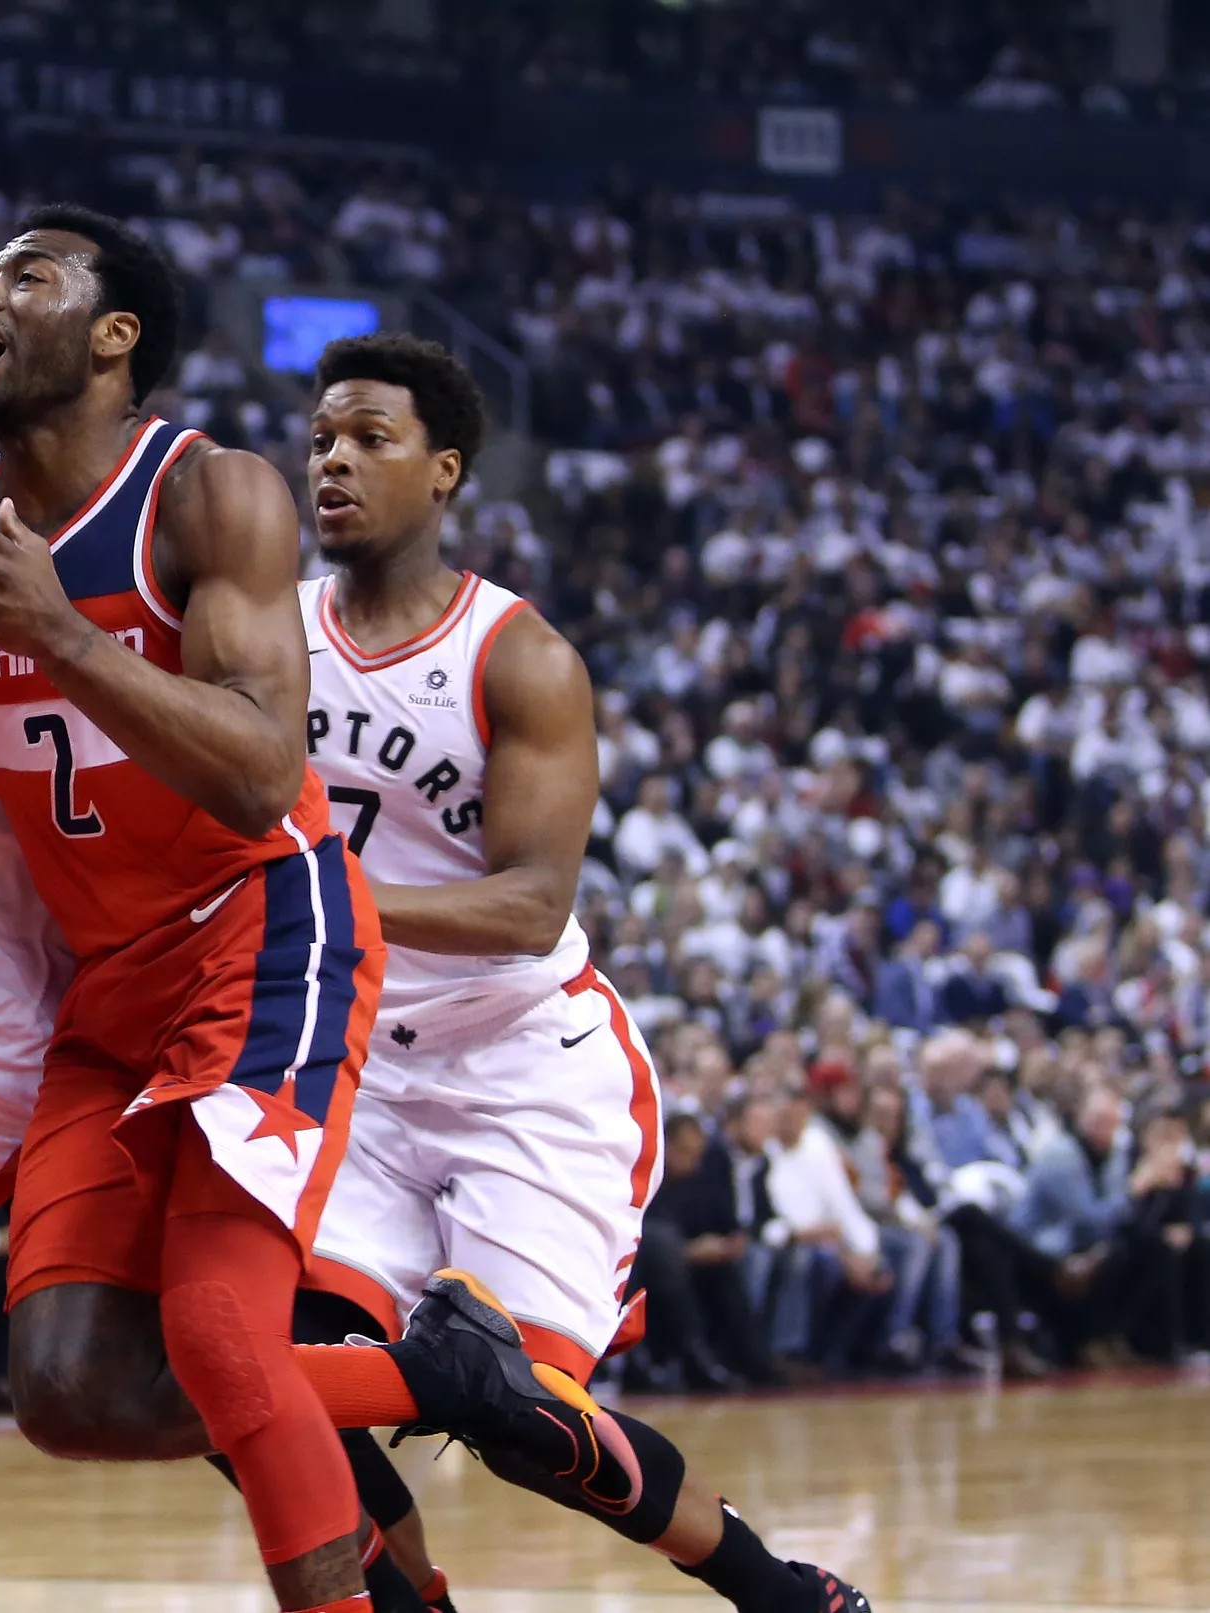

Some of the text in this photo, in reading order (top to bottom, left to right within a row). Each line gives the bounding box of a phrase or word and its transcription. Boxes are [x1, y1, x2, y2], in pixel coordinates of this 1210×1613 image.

[407, 693, 458, 709] Sun Life
[23, 711, 106, 839] 2
[328, 785, 381, 858] 7
